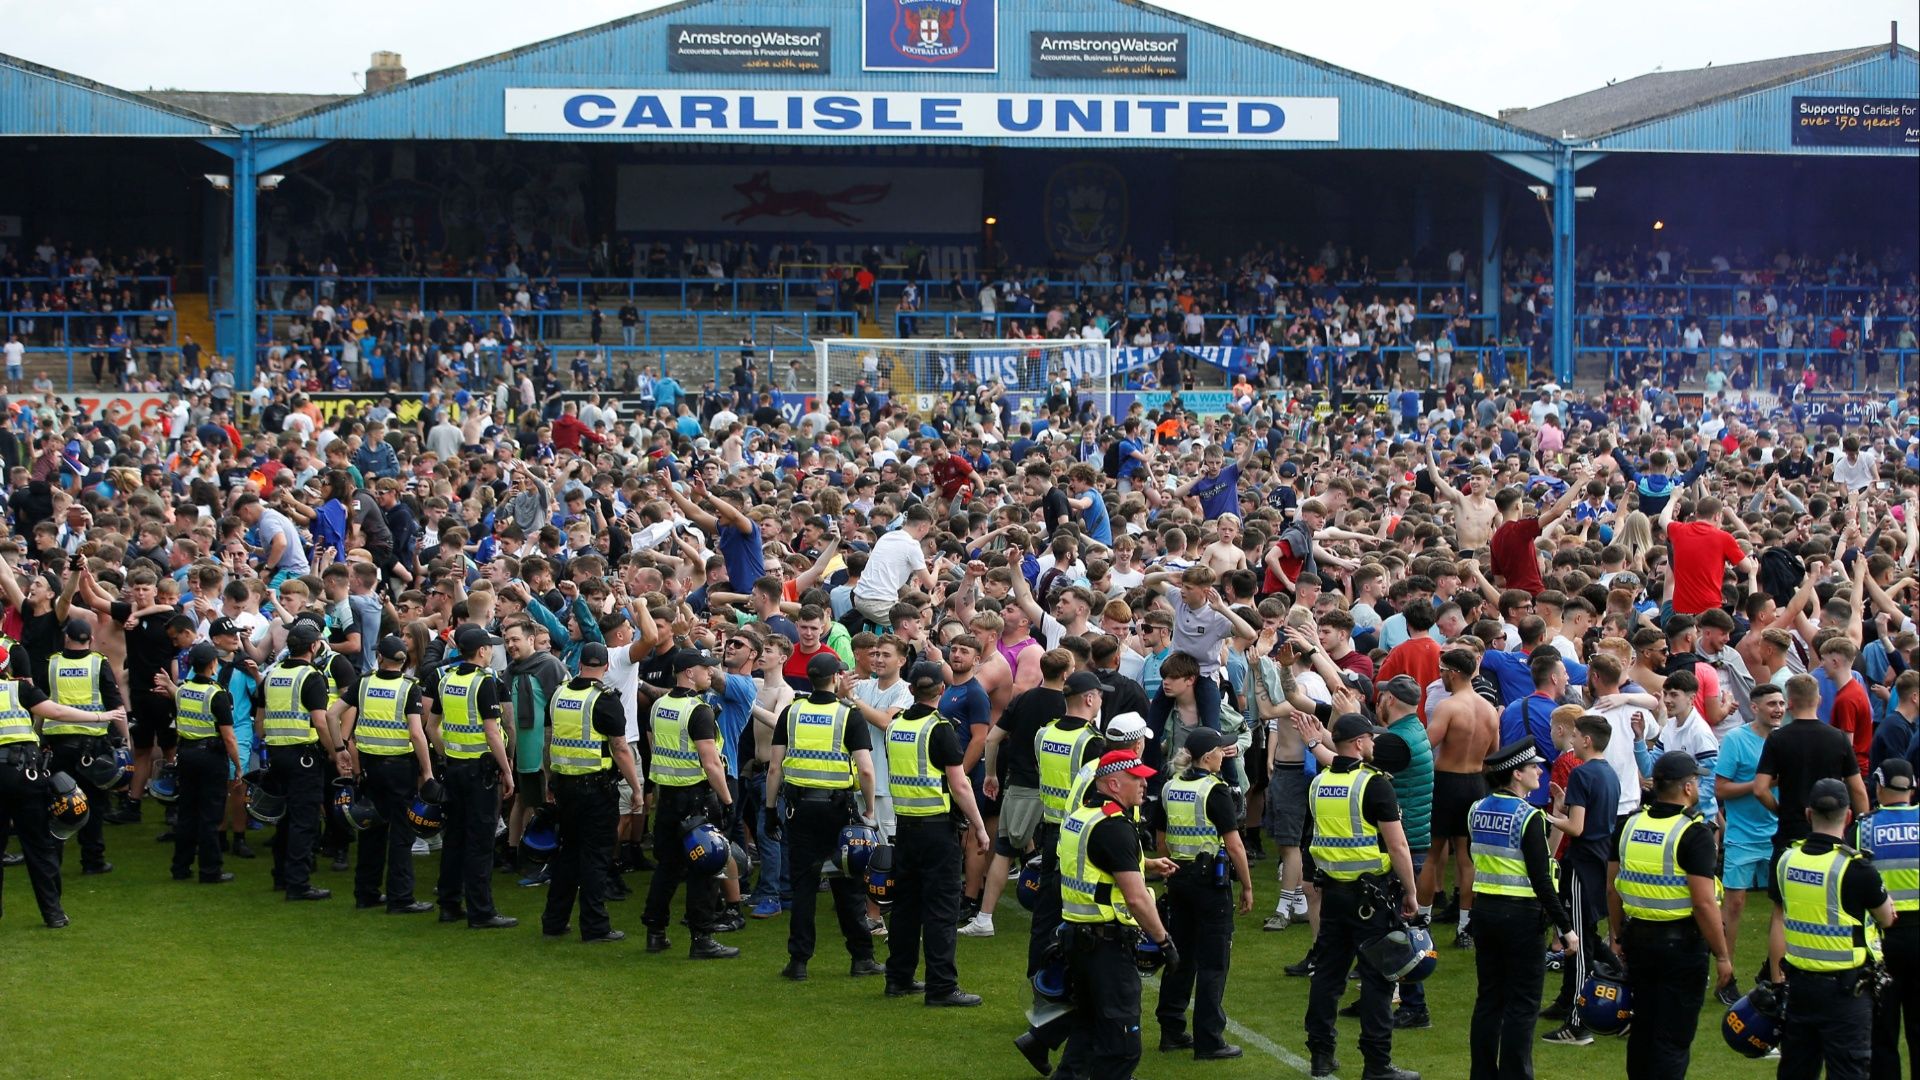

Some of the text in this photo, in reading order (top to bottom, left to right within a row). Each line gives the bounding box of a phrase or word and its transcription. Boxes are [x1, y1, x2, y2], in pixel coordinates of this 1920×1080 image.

[678, 47, 722, 56] Accountants,
[723, 48, 752, 56] Business
[902, 45, 958, 56] FOOTBALL CLUB
[1040, 54, 1082, 62] Accountants,
[1084, 54, 1112, 62] Business
[773, 58, 796, 68] with
[798, 62, 819, 71] you
[1132, 63, 1154, 74] with
[1156, 67, 1176, 77] you
[563, 94, 1286, 134] CARLISLE UNITED
[1800, 103, 1916, 117] Supporting Carlisle for
[1800, 116, 1901, 131] over 150 years
[921, 397, 929, 409] 3
[60, 668, 88, 677] POLICE
[271, 678, 292, 687] POLICE
[180, 690, 205, 699] POLICE
[368, 689, 395, 698] POLICE
[445, 686, 466, 696] POLICE
[557, 700, 582, 710] POLICE
[658, 708, 679, 719] POLICE
[800, 714, 832, 725] POLICE
[891, 732, 915, 742] POLICE
[1042, 742, 1070, 755] POLICE
[1168, 790, 1195, 801] POLICE
[1318, 786, 1348, 798] POLICE
[1474, 812, 1512, 834] POLICE
[848, 837, 872, 847] 2432
[1633, 831, 1664, 844] POLICE
[689, 845, 705, 862] BB
[1788, 869, 1824, 885] POLICE
[869, 883, 886, 897] BB
[1595, 984, 1616, 1000] BB
[1727, 1011, 1744, 1034] BB
